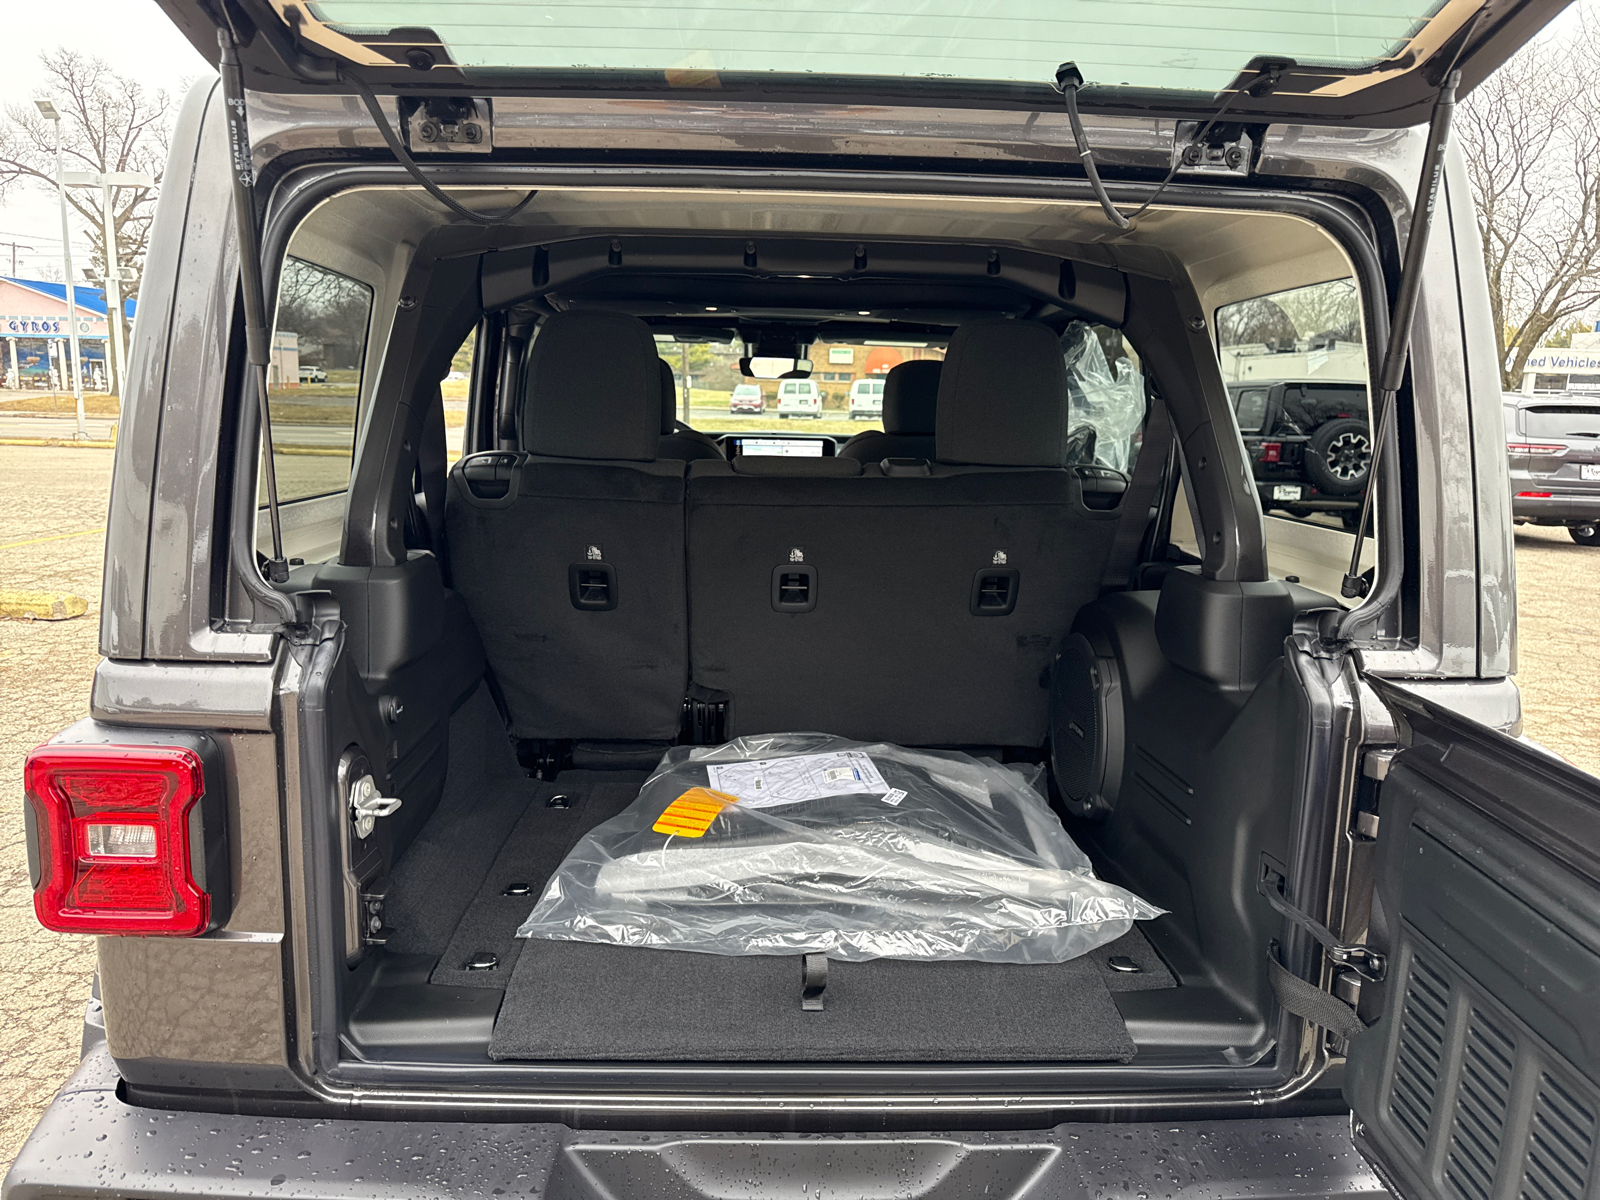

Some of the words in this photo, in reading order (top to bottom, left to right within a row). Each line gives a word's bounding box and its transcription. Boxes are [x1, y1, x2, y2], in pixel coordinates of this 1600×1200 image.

[230, 120, 241, 171] STABILUS
[1427, 164, 1440, 212] STABILUS
[9, 320, 60, 333] GYROS
[1551, 356, 1600, 368] Vehicles
